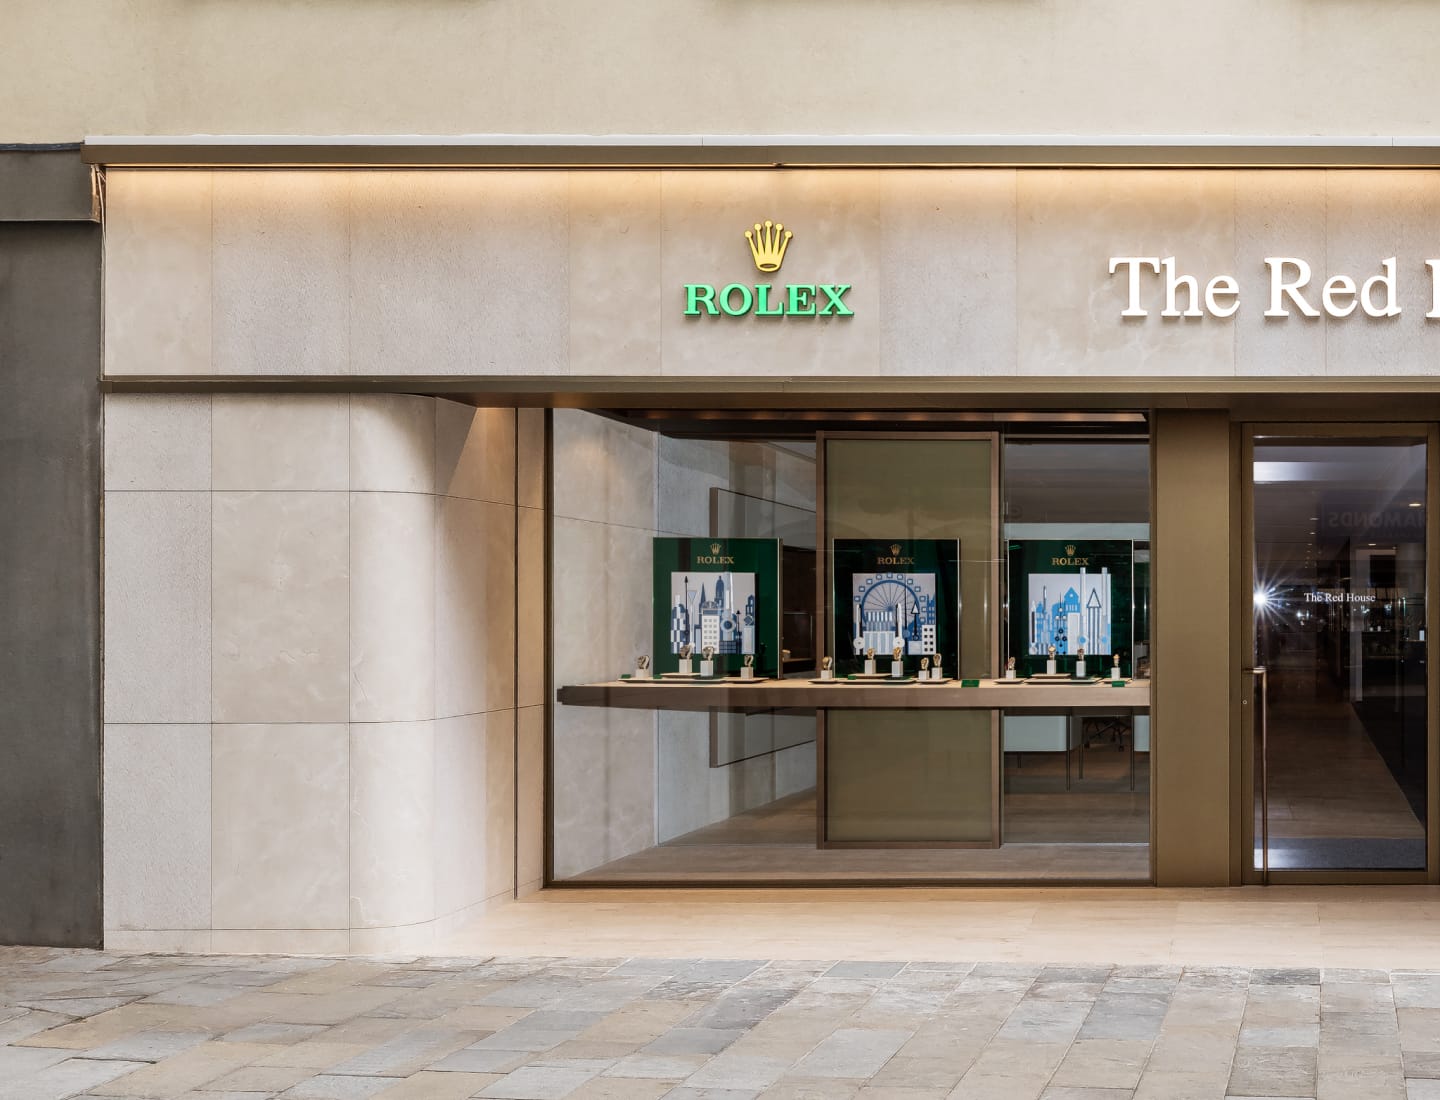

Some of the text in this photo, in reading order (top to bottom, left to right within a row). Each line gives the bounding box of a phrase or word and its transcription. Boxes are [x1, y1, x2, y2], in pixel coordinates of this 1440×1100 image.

[1108, 256, 1241, 319] The
[1263, 256, 1402, 319] Red
[683, 283, 855, 317] ROLEX
[696, 556, 735, 565] ROLEX
[876, 557, 915, 565] ROLEX
[1051, 557, 1090, 566] ROLEX
[1303, 592, 1377, 603] The Red House
